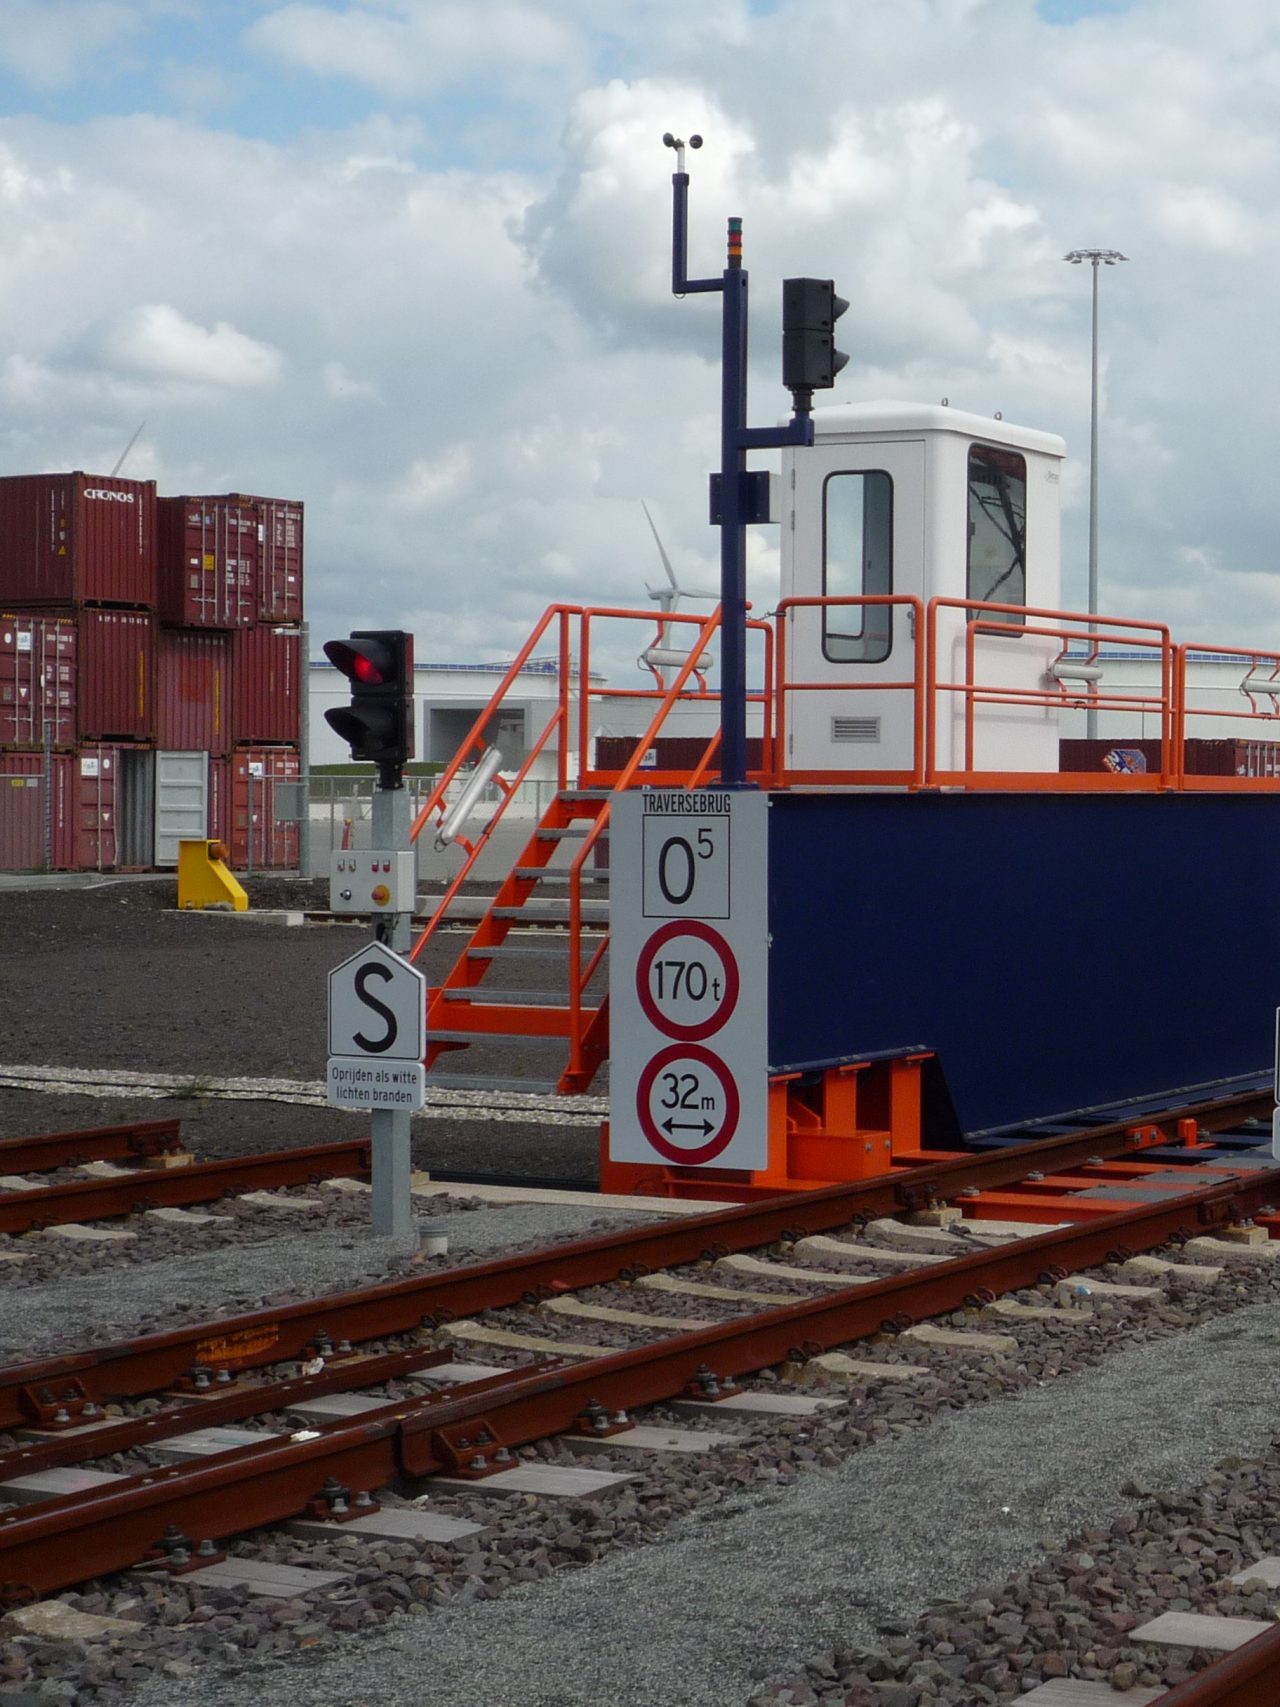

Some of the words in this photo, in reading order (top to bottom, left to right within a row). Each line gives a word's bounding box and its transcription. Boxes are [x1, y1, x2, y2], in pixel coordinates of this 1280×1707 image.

[83, 488, 134, 504] CRONOS
[642, 793, 731, 813] TRAVERSEBRUG
[352, 961, 398, 1054] S
[332, 1066, 373, 1085] Oprijden
[375, 1070, 390, 1083] als
[392, 1071, 417, 1084] witte
[336, 1086, 370, 1100] lichten
[373, 1088, 412, 1103] branden
